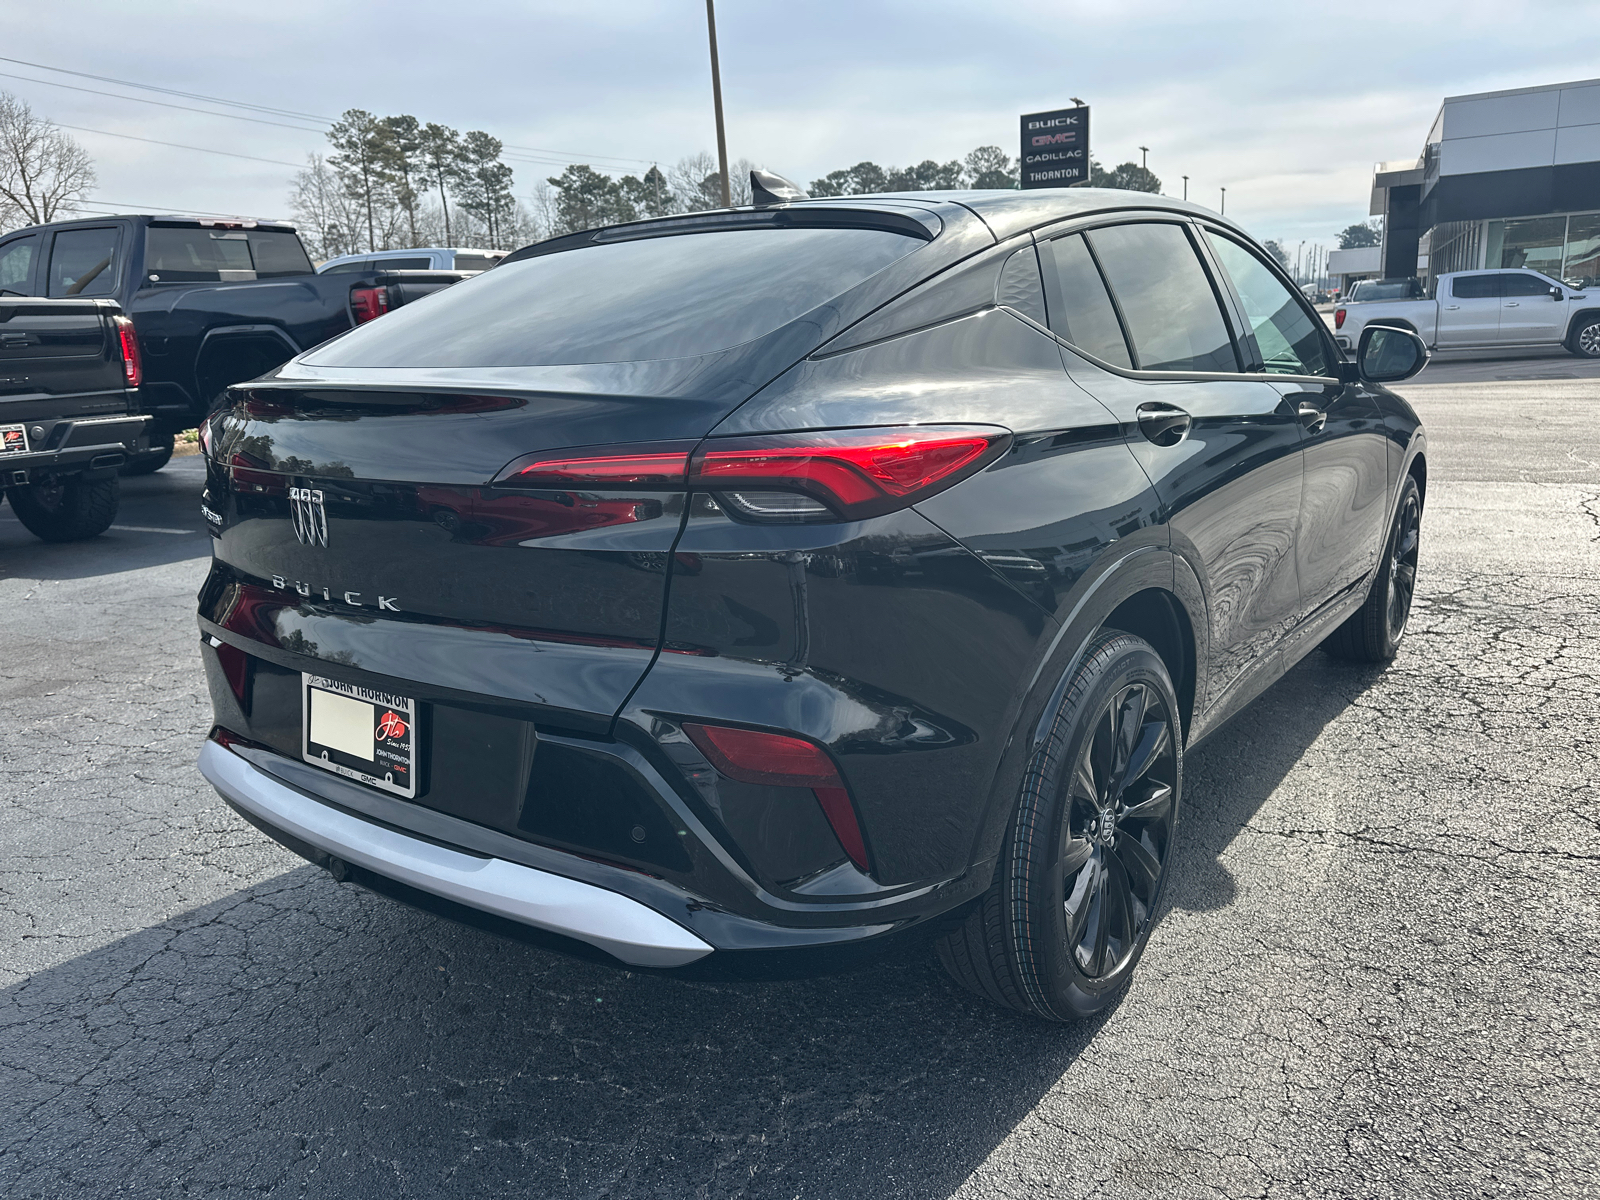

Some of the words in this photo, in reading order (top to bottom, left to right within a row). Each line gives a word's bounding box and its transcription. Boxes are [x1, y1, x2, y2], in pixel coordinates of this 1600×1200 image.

[1028, 116, 1079, 130] BUICK
[1032, 132, 1076, 146] GMC
[1026, 150, 1082, 163] CADILLAC
[1030, 168, 1079, 181] THORNTON
[272, 574, 400, 612] BUICK
[329, 680, 353, 694] JOHN
[357, 686, 409, 710] THORNTON
[341, 767, 354, 778] BUICK
[361, 774, 377, 785] GMC
[394, 764, 407, 774] GMC
